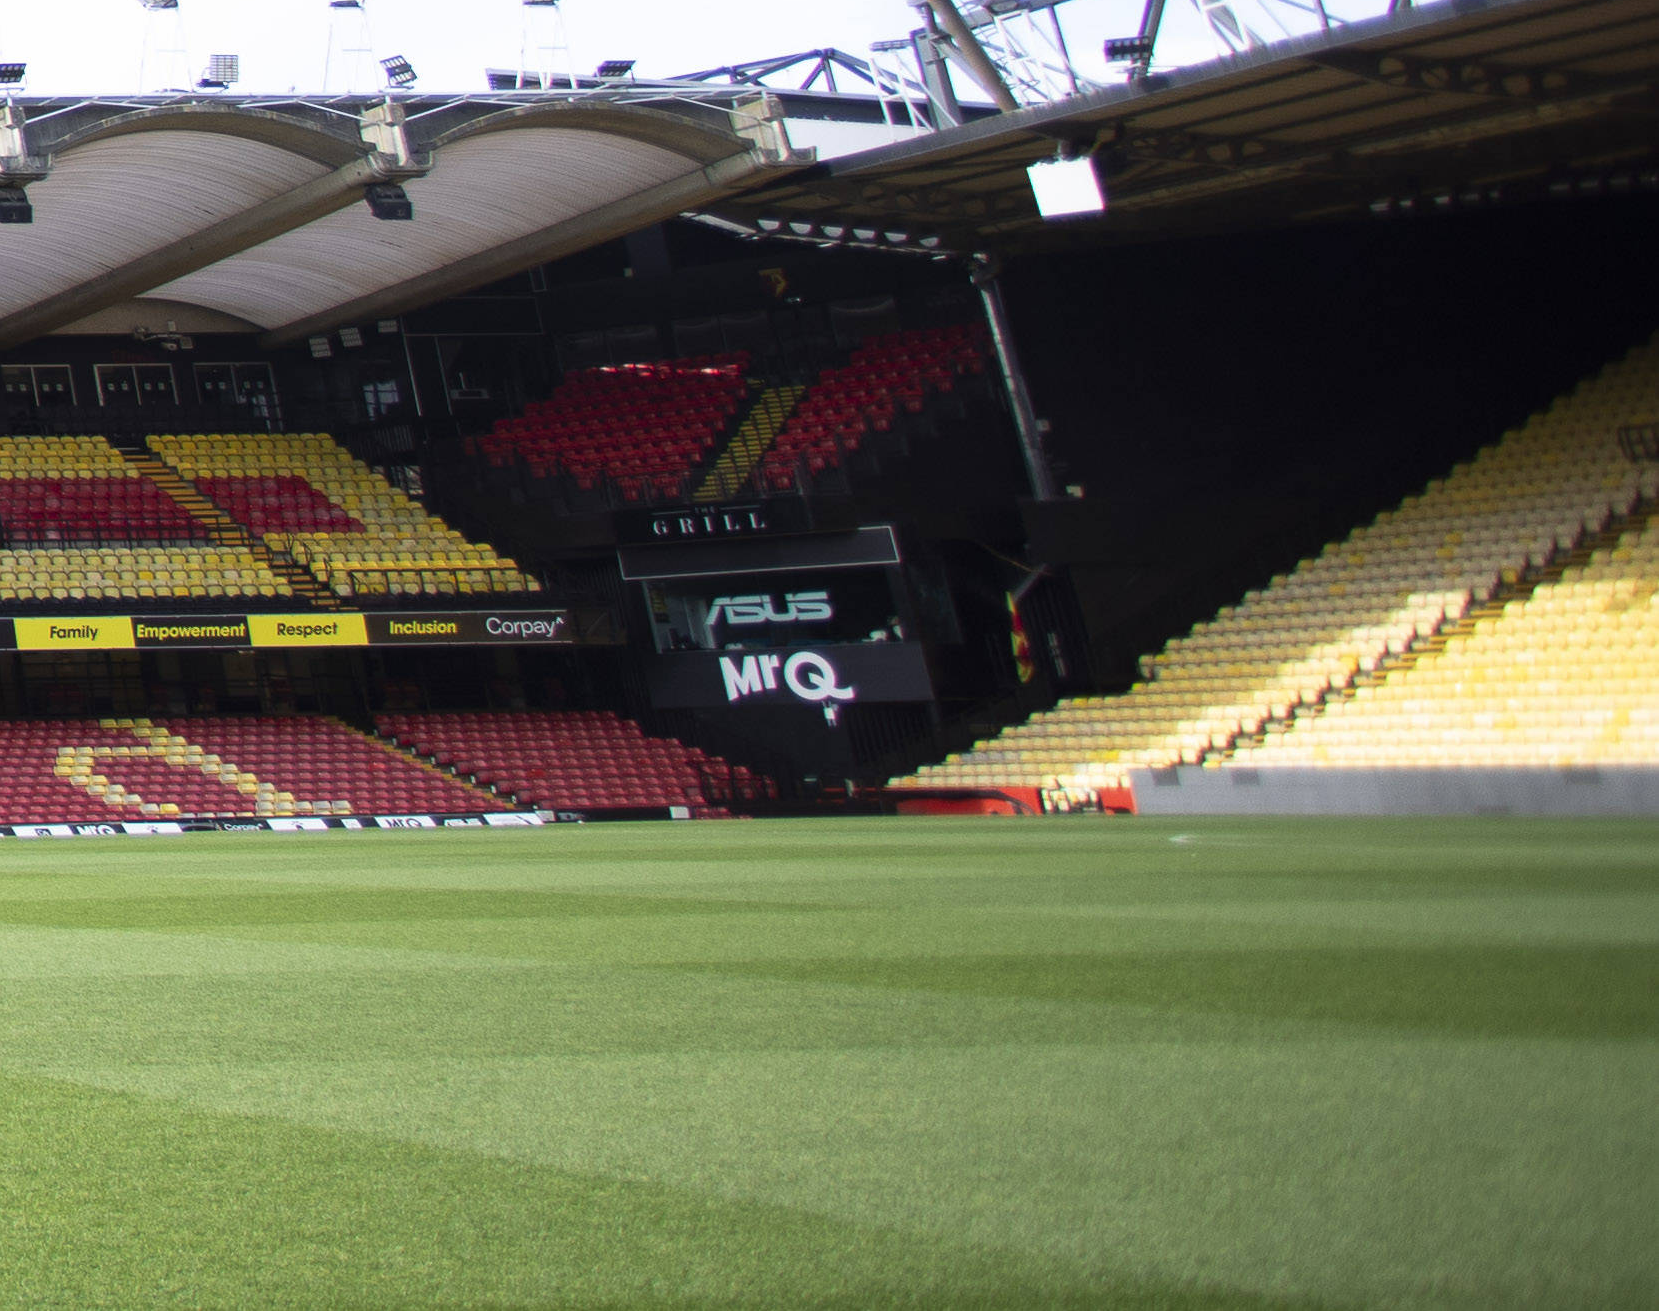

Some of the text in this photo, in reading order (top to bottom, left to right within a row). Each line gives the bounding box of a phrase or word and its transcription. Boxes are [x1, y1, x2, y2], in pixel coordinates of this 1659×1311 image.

[652, 511, 767, 537] GRILL
[704, 590, 834, 626] ASUS
[49, 624, 98, 641] Family
[136, 623, 246, 640] Empowerment
[277, 622, 338, 639] Respect
[389, 619, 457, 635] Inclusion
[718, 651, 856, 702] MrQ
